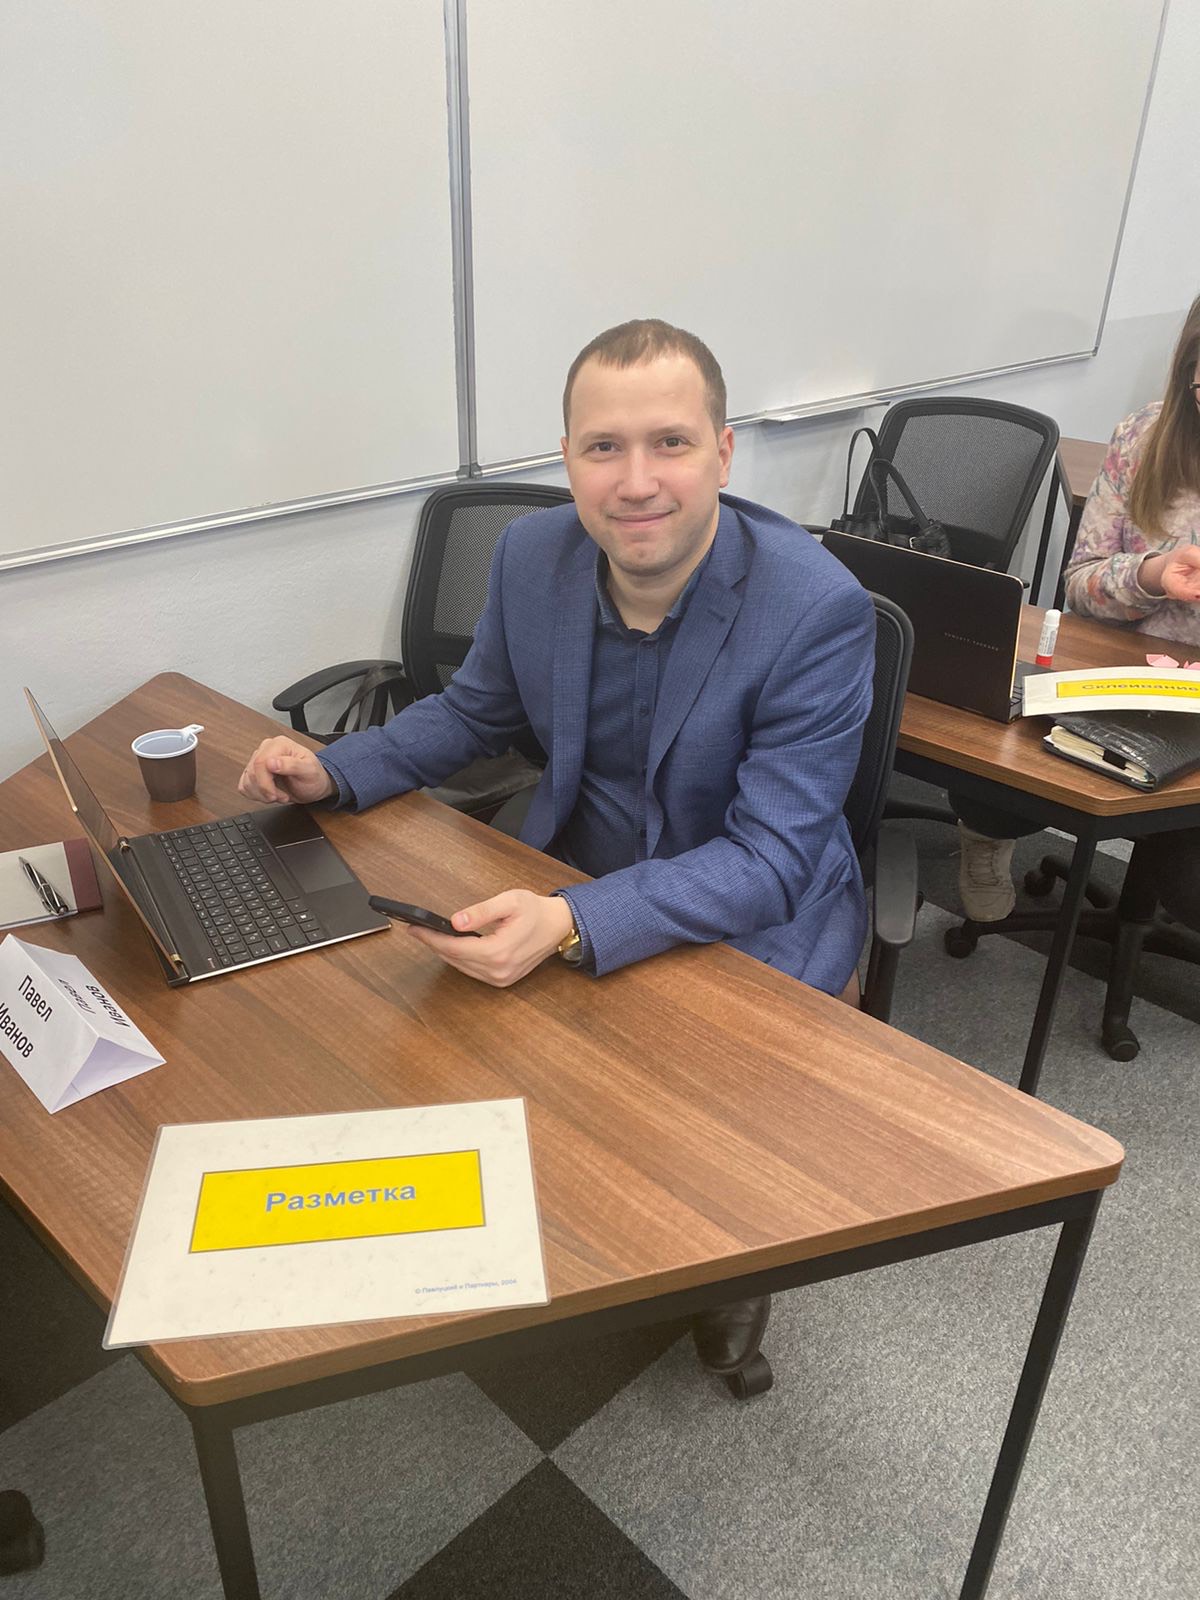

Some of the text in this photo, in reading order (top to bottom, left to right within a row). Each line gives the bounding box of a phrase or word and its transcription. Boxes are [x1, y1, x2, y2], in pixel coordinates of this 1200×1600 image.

[18, 975, 53, 1022] Павел
[86, 984, 130, 1028] Иванов
[265, 1184, 416, 1213] Разметка
